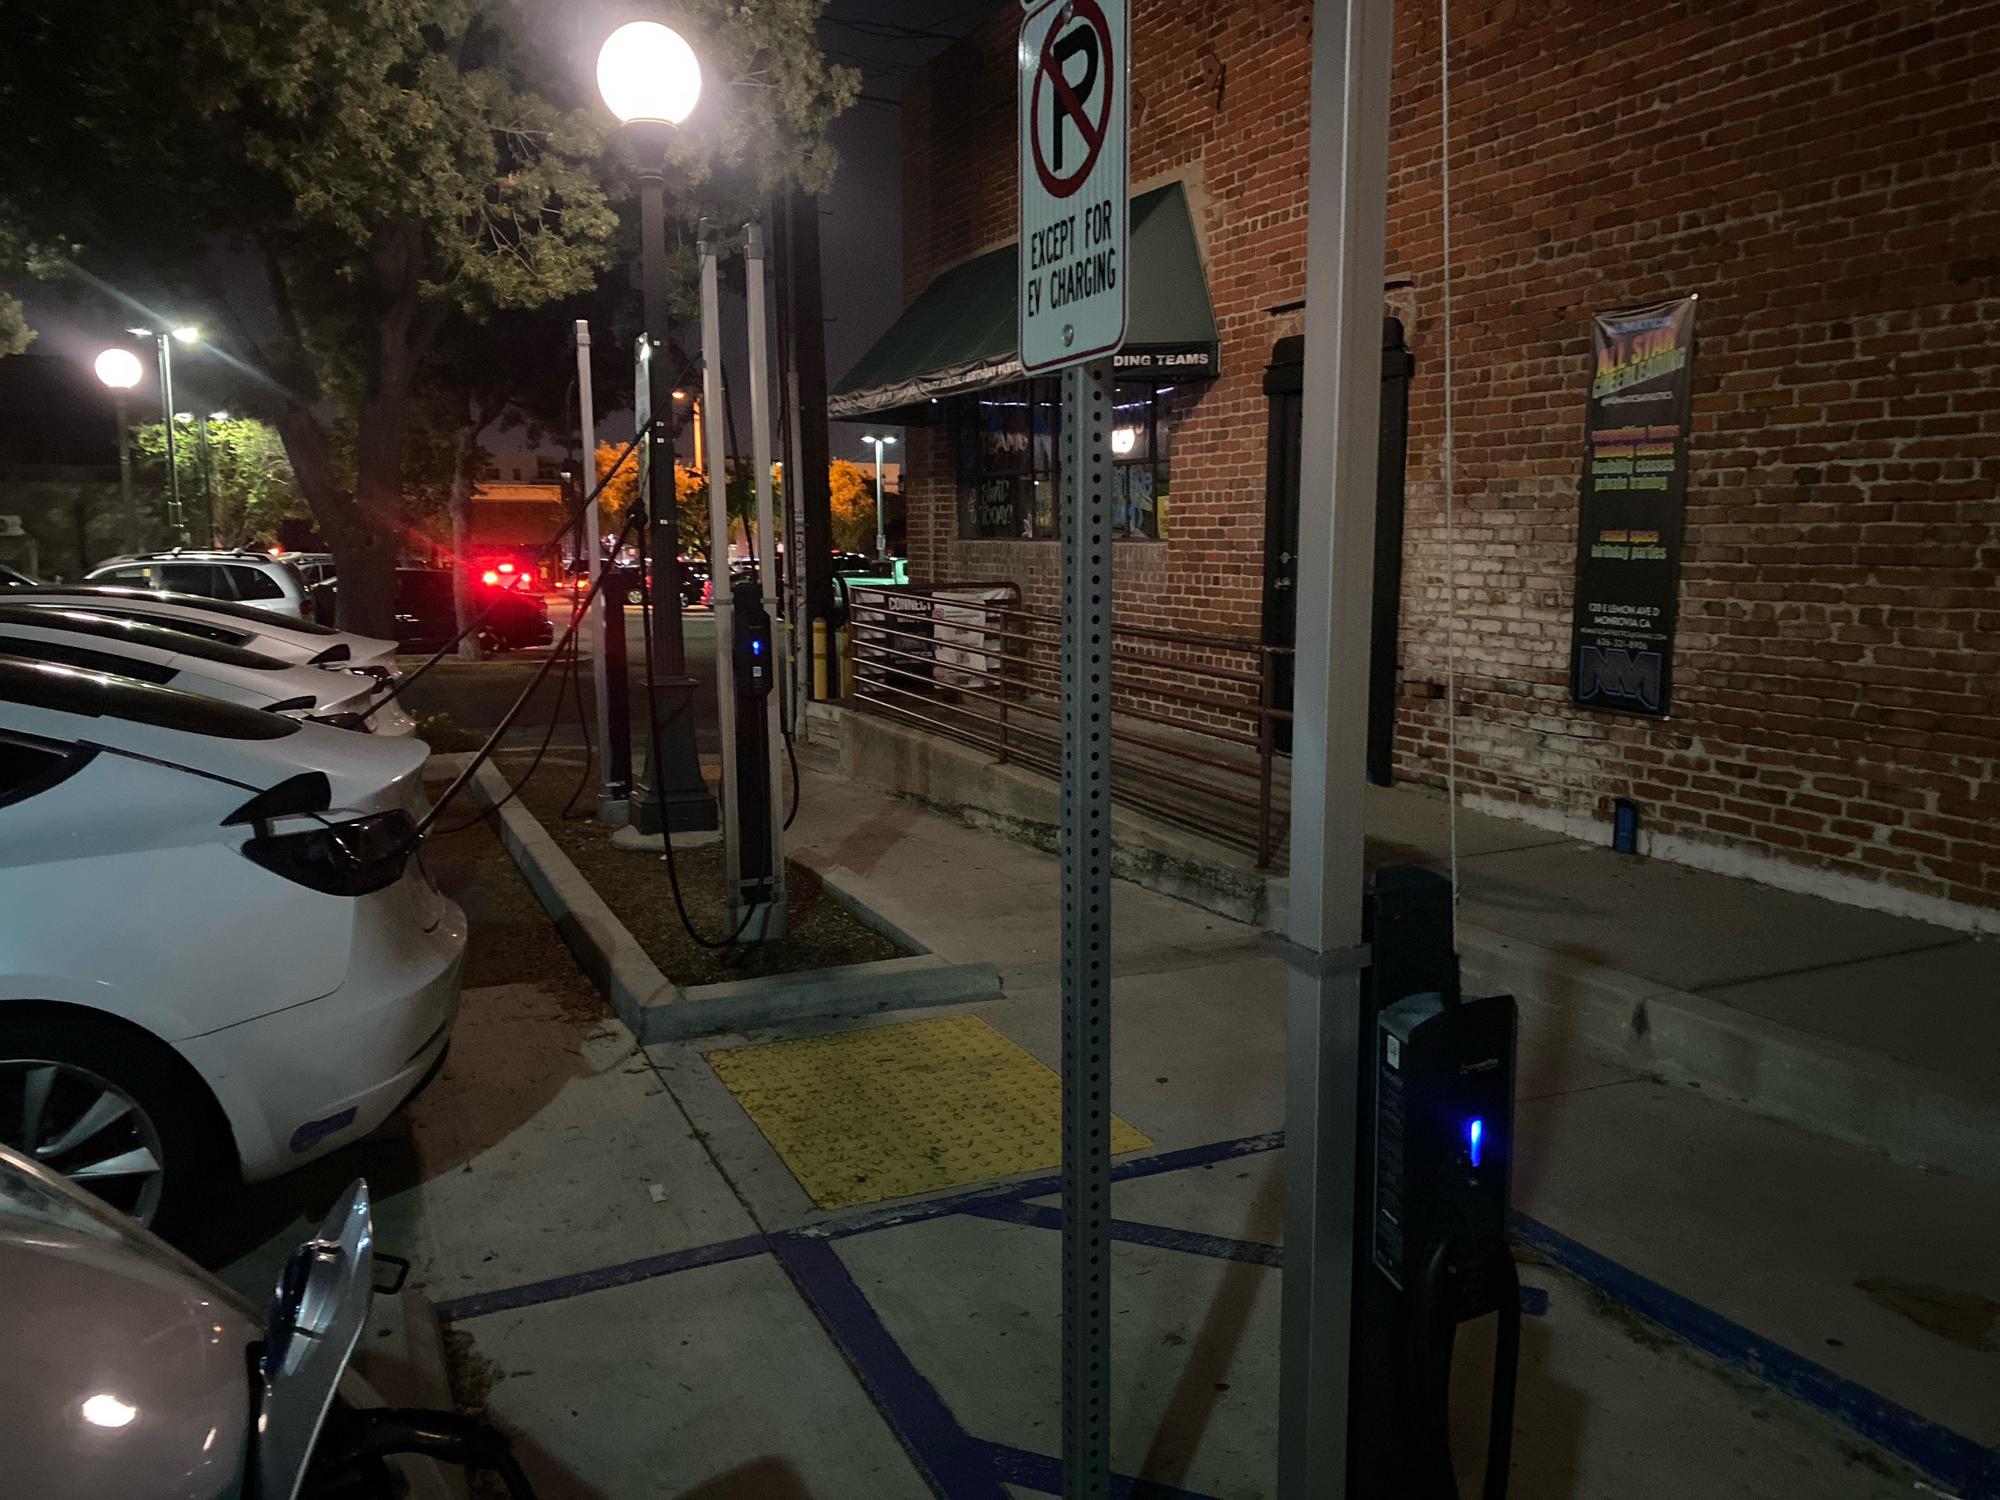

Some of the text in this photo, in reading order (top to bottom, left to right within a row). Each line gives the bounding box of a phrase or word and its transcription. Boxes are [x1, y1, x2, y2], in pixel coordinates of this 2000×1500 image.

[1031, 199, 1111, 271] EXCEPT FOR
[1028, 248, 1116, 317] EV CHARGING
[1156, 353, 1209, 366] TEAMS
[1639, 618, 1651, 628] CA
